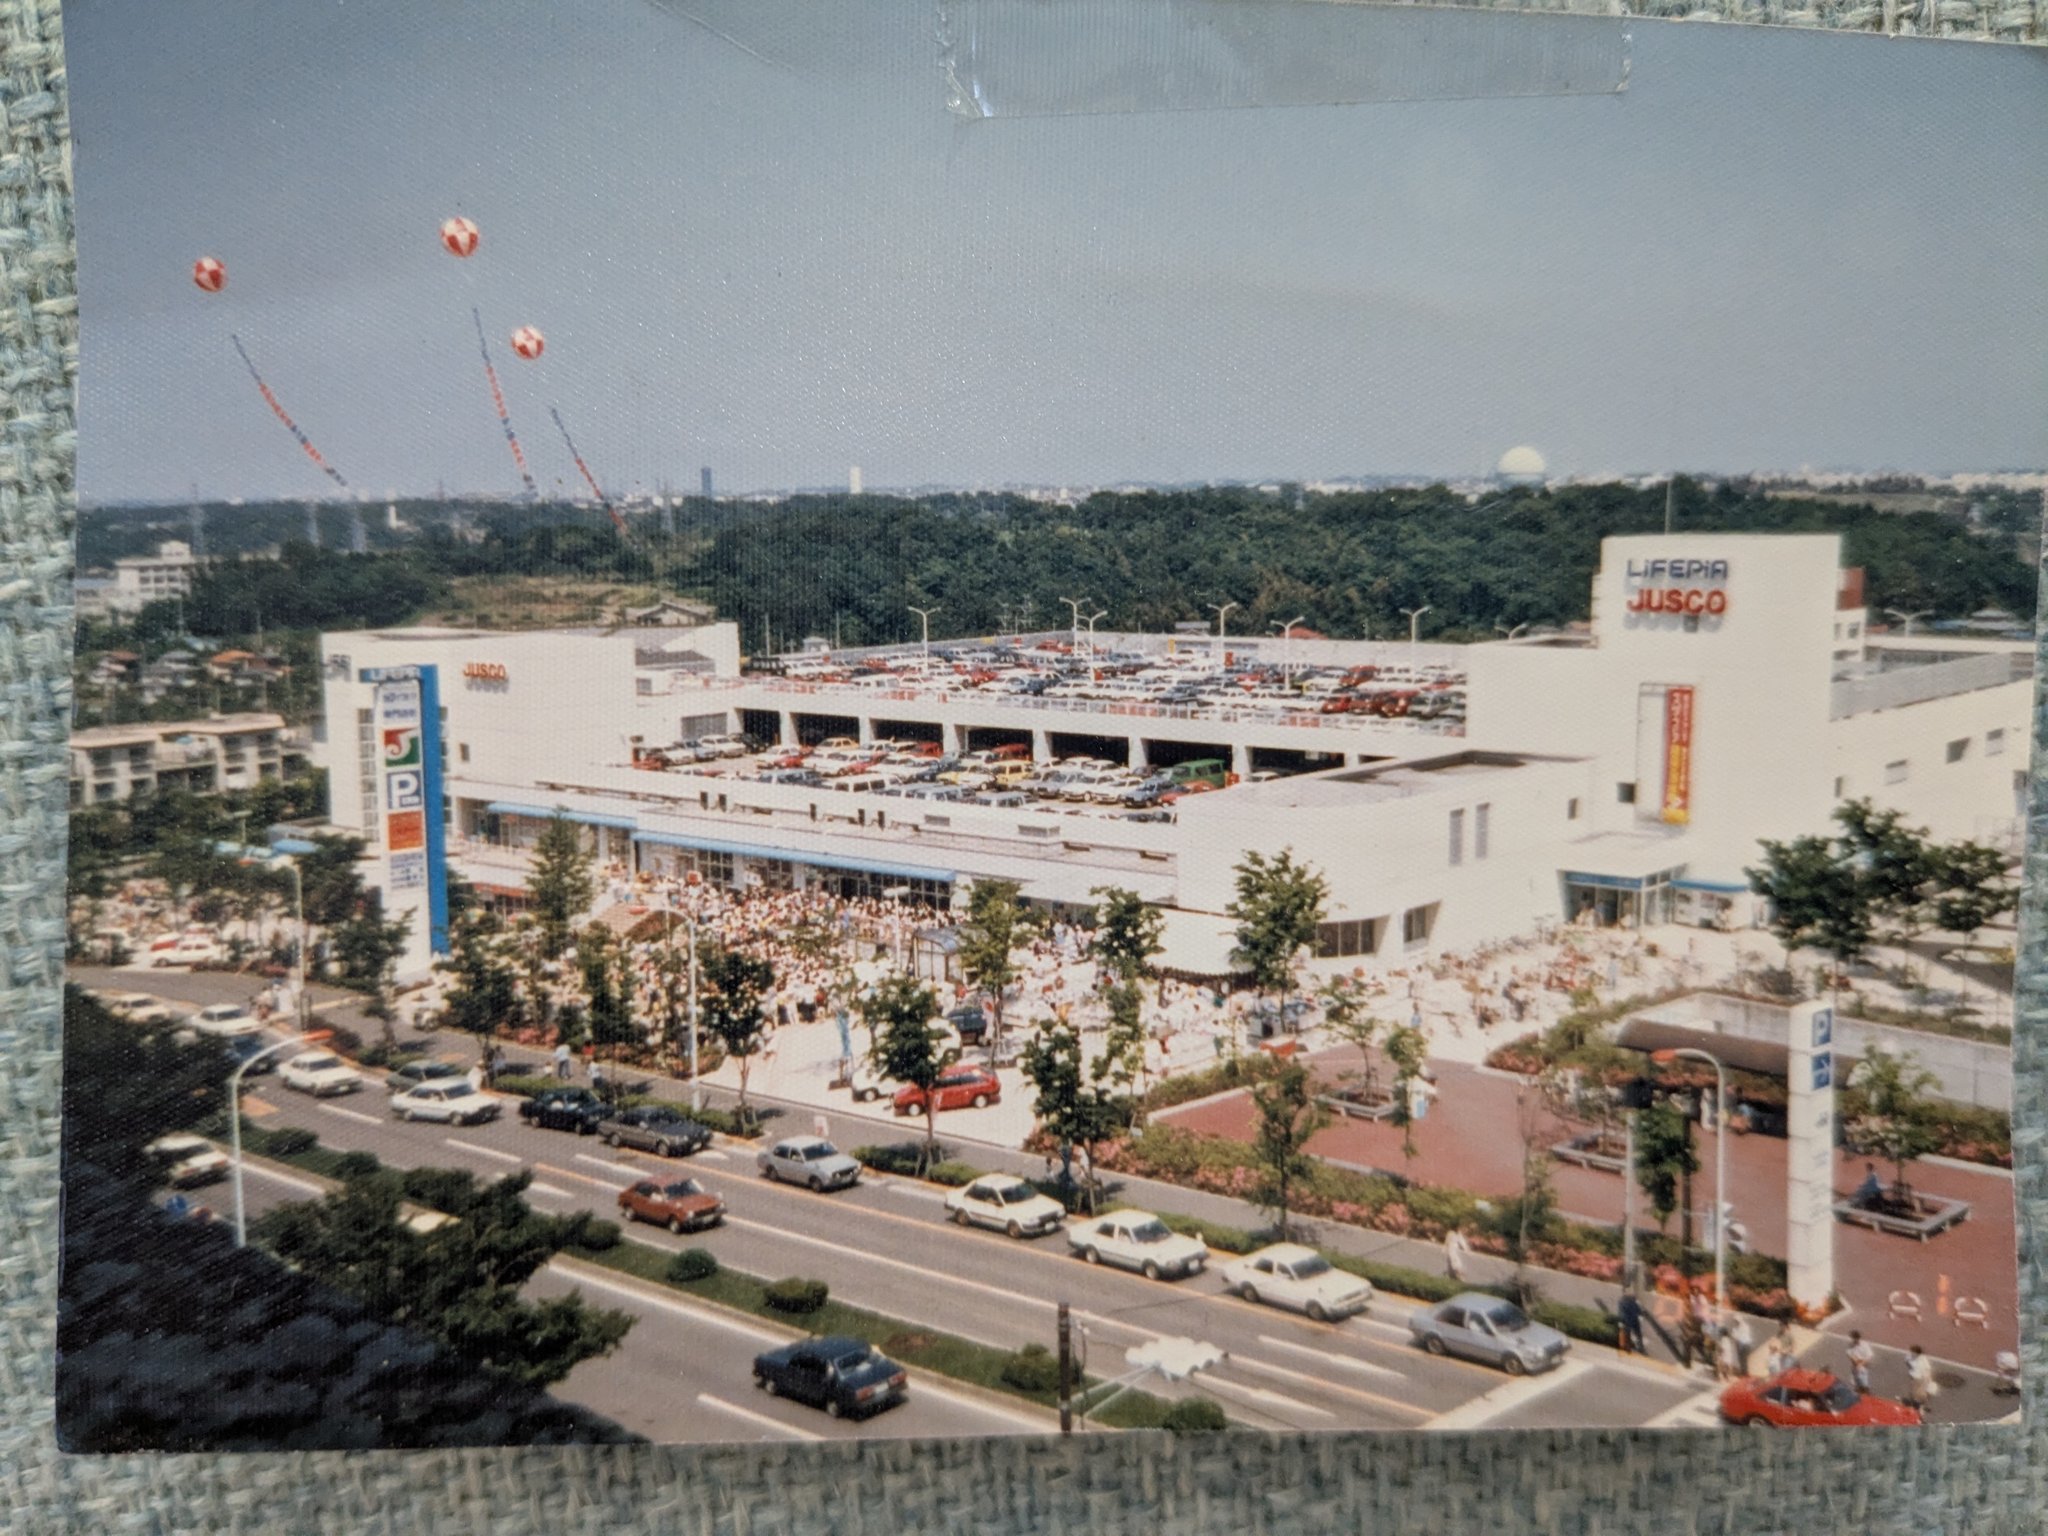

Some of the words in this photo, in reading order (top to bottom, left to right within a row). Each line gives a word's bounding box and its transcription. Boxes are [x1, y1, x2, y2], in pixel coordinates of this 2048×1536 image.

[1627, 588, 1726, 615] JUSCO
[463, 662, 507, 681] JUSCO
[390, 773, 418, 809] P
[1812, 1012, 1828, 1047] P
